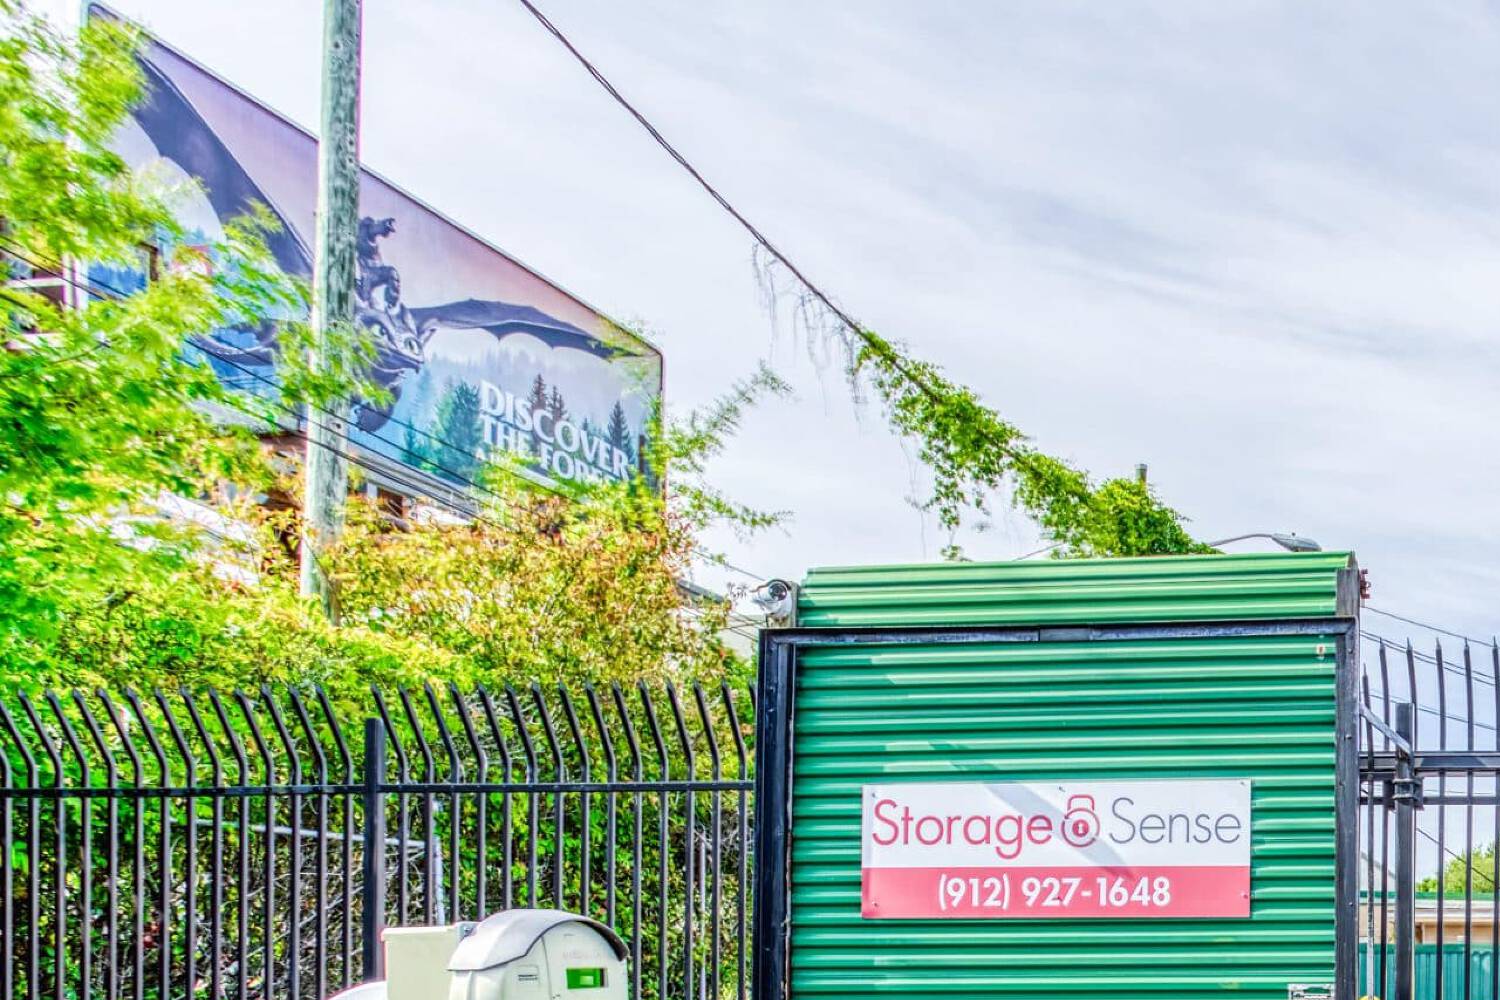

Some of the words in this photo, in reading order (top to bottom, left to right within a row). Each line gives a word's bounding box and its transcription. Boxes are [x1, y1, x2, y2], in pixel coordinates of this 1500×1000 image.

[479, 414, 535, 458] THE
[539, 442, 617, 484] FORE
[480, 380, 630, 482] DISCOVER
[872, 799, 1053, 860] Storage
[1109, 797, 1242, 845] Sense
[938, 873, 1011, 911] (912)
[1021, 876, 1171, 908] 927-1648
